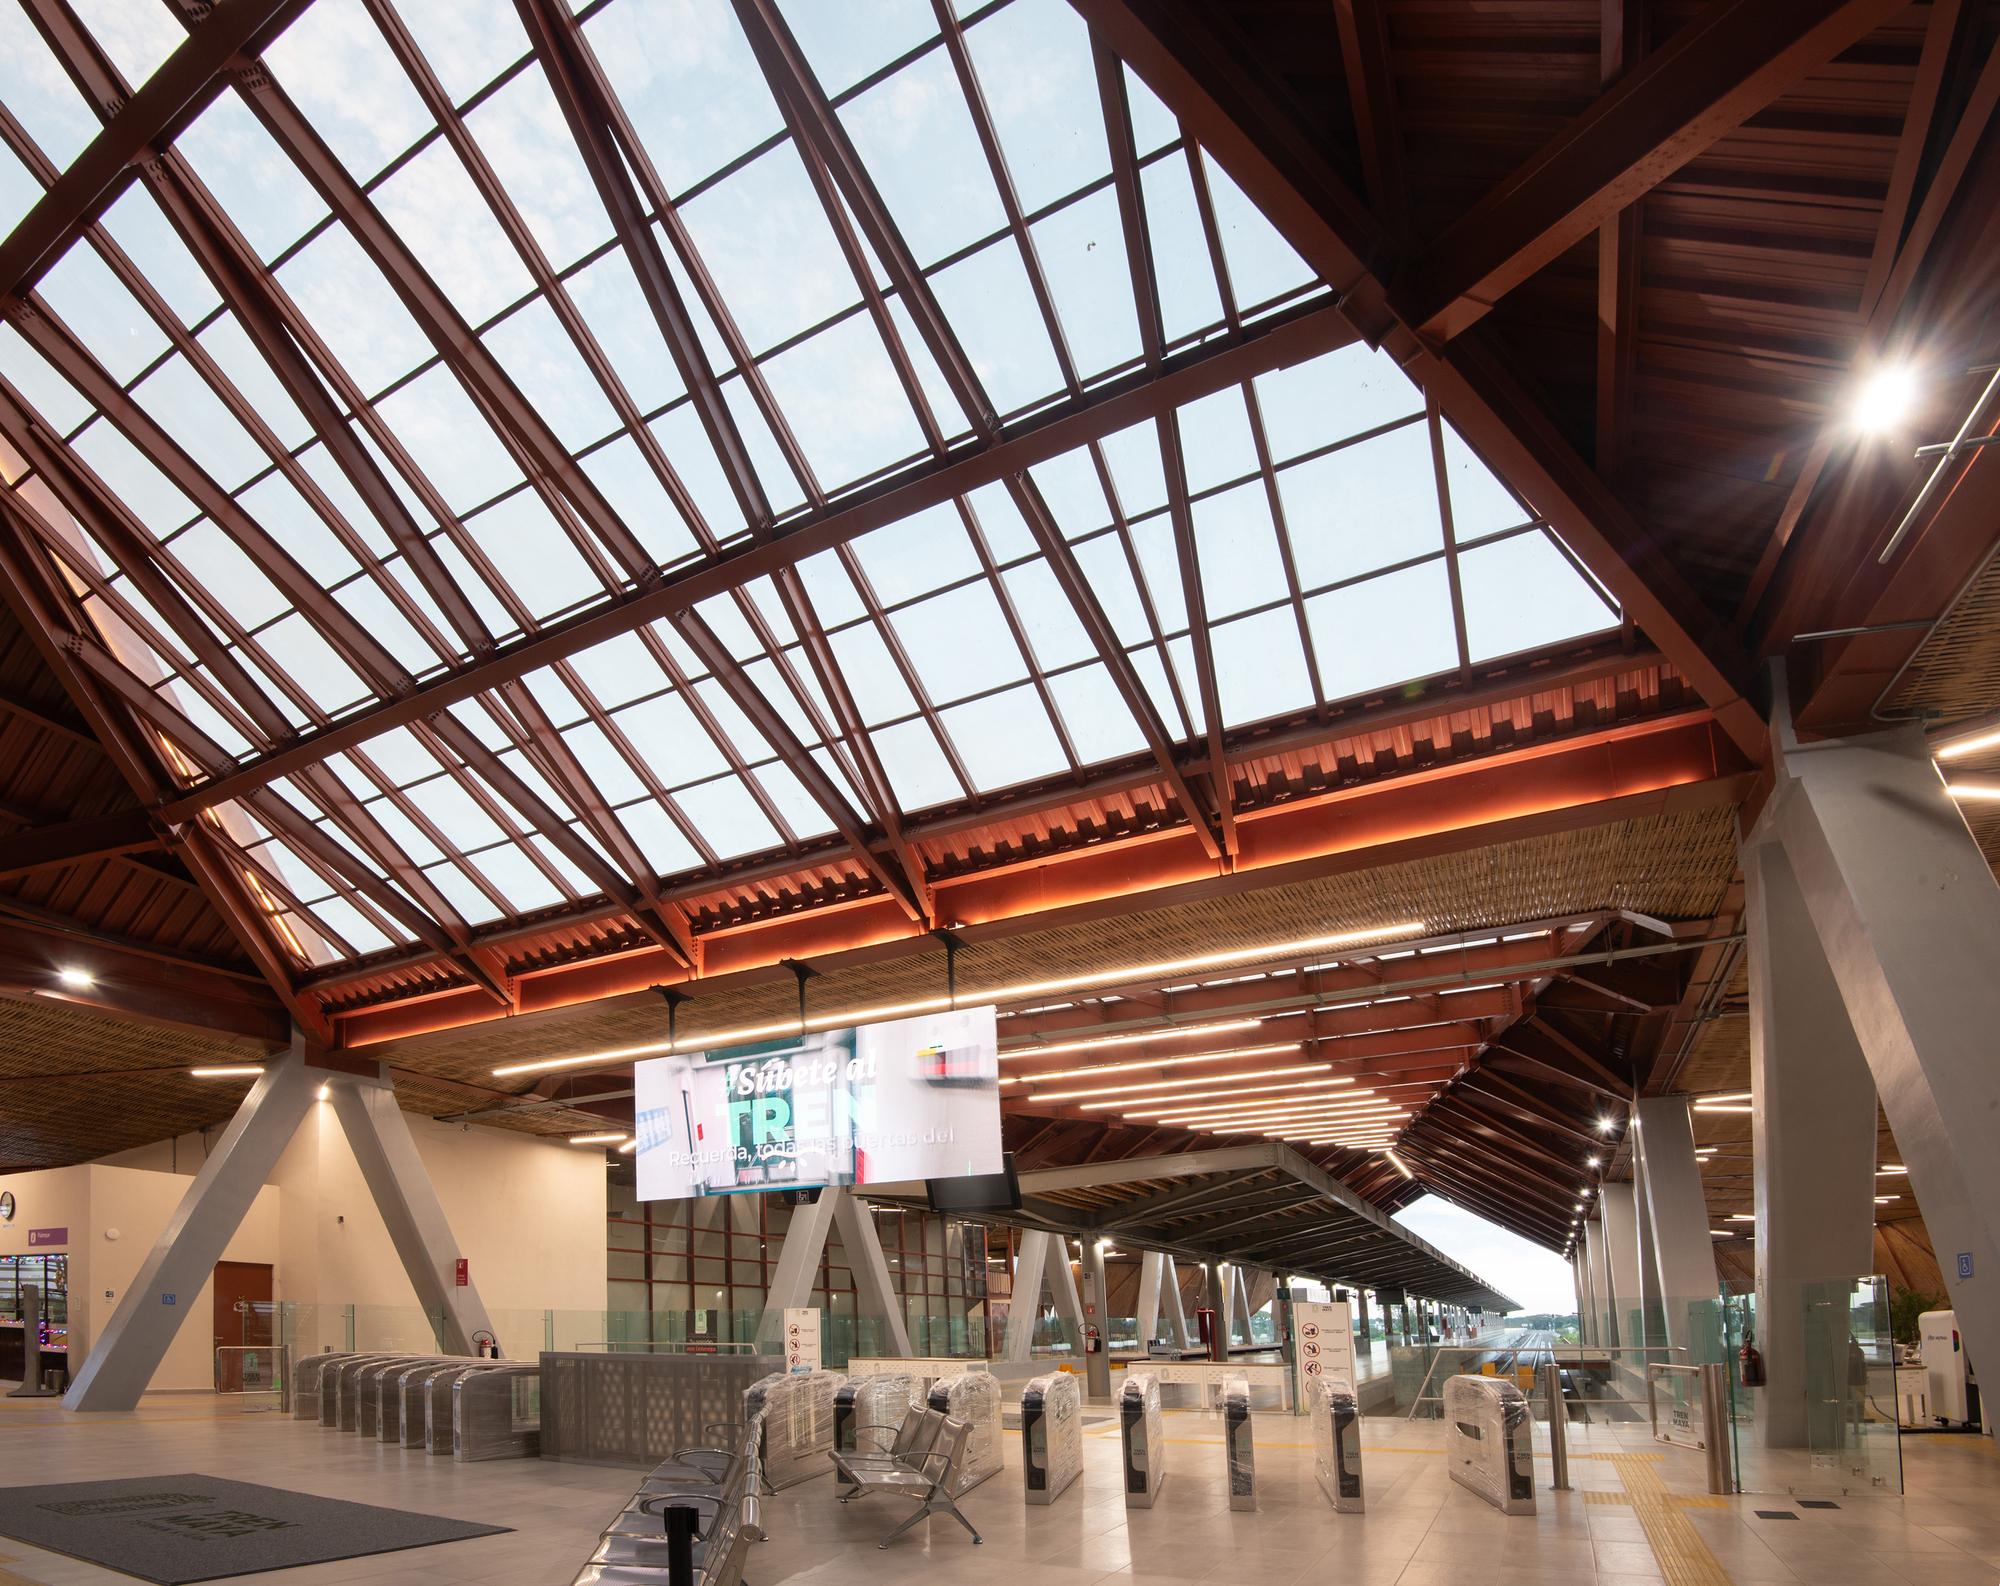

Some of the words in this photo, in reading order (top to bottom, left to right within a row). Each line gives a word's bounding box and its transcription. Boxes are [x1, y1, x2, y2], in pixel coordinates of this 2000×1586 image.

[846, 1047, 878, 1082] al
[715, 1084, 878, 1148] TREN
[844, 1129, 918, 1155] puertas
[923, 1125, 955, 1145] del
[1673, 1410, 1689, 1420] TREN
[1673, 1418, 1690, 1428] MAYA
